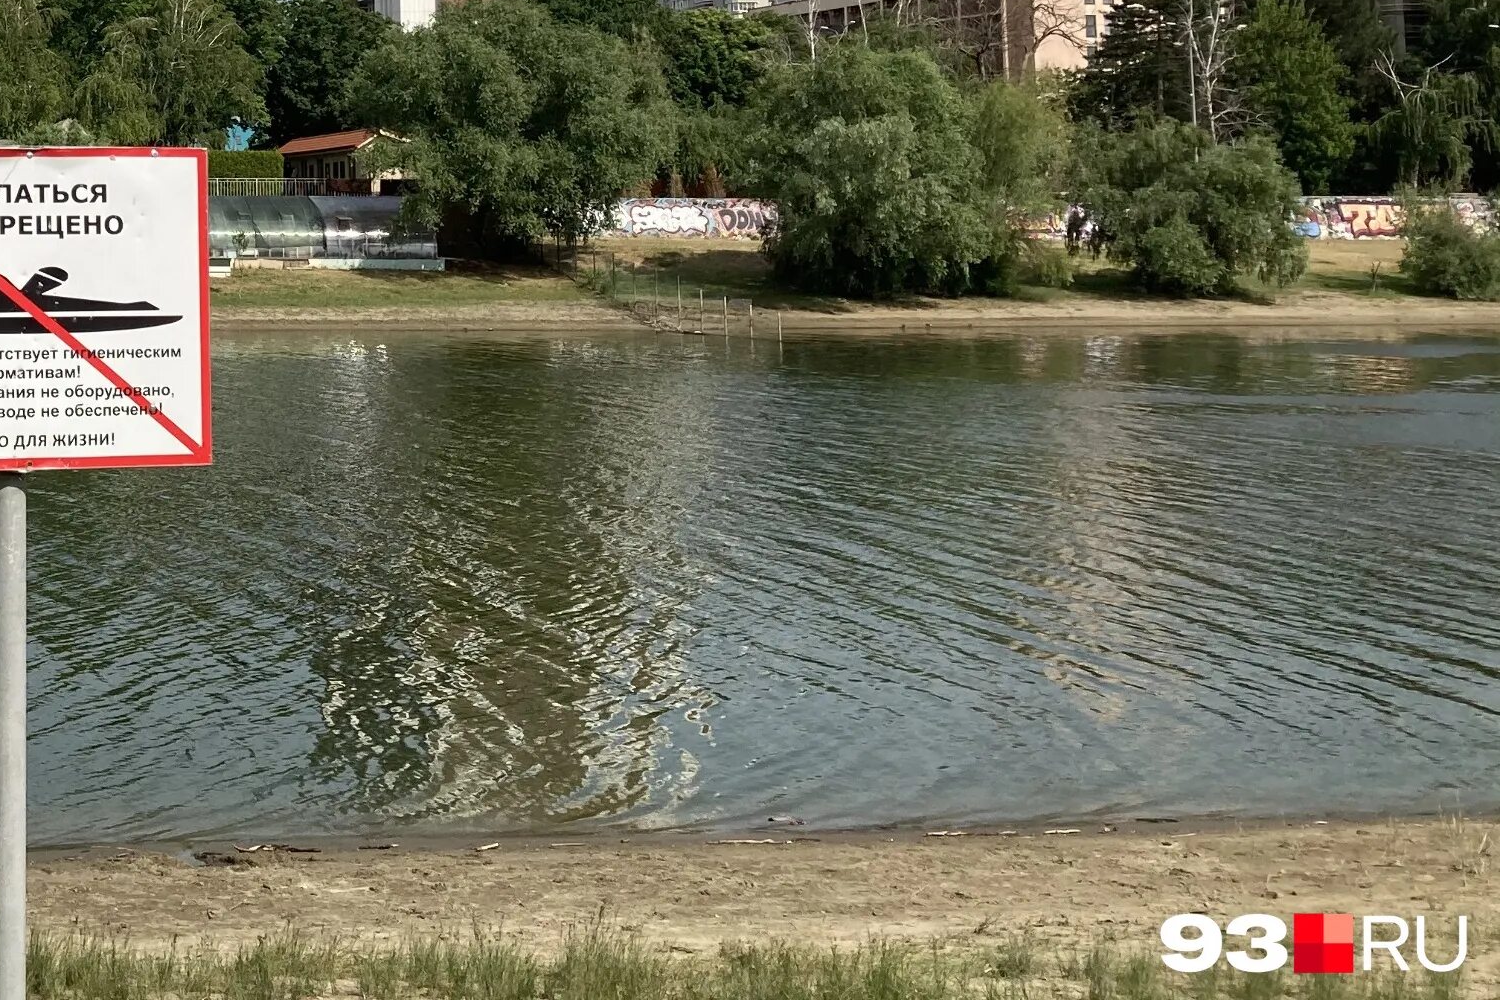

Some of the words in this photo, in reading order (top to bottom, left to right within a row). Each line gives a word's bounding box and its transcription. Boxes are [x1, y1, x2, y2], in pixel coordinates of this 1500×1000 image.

[63, 347, 182, 360] гигиеническим
[41, 387, 59, 398] не
[64, 384, 175, 401] оборудовано,
[41, 407, 60, 418] не
[13, 434, 47, 450] ДЛЯ
[52, 432, 115, 447] ЖИЗНИ!
